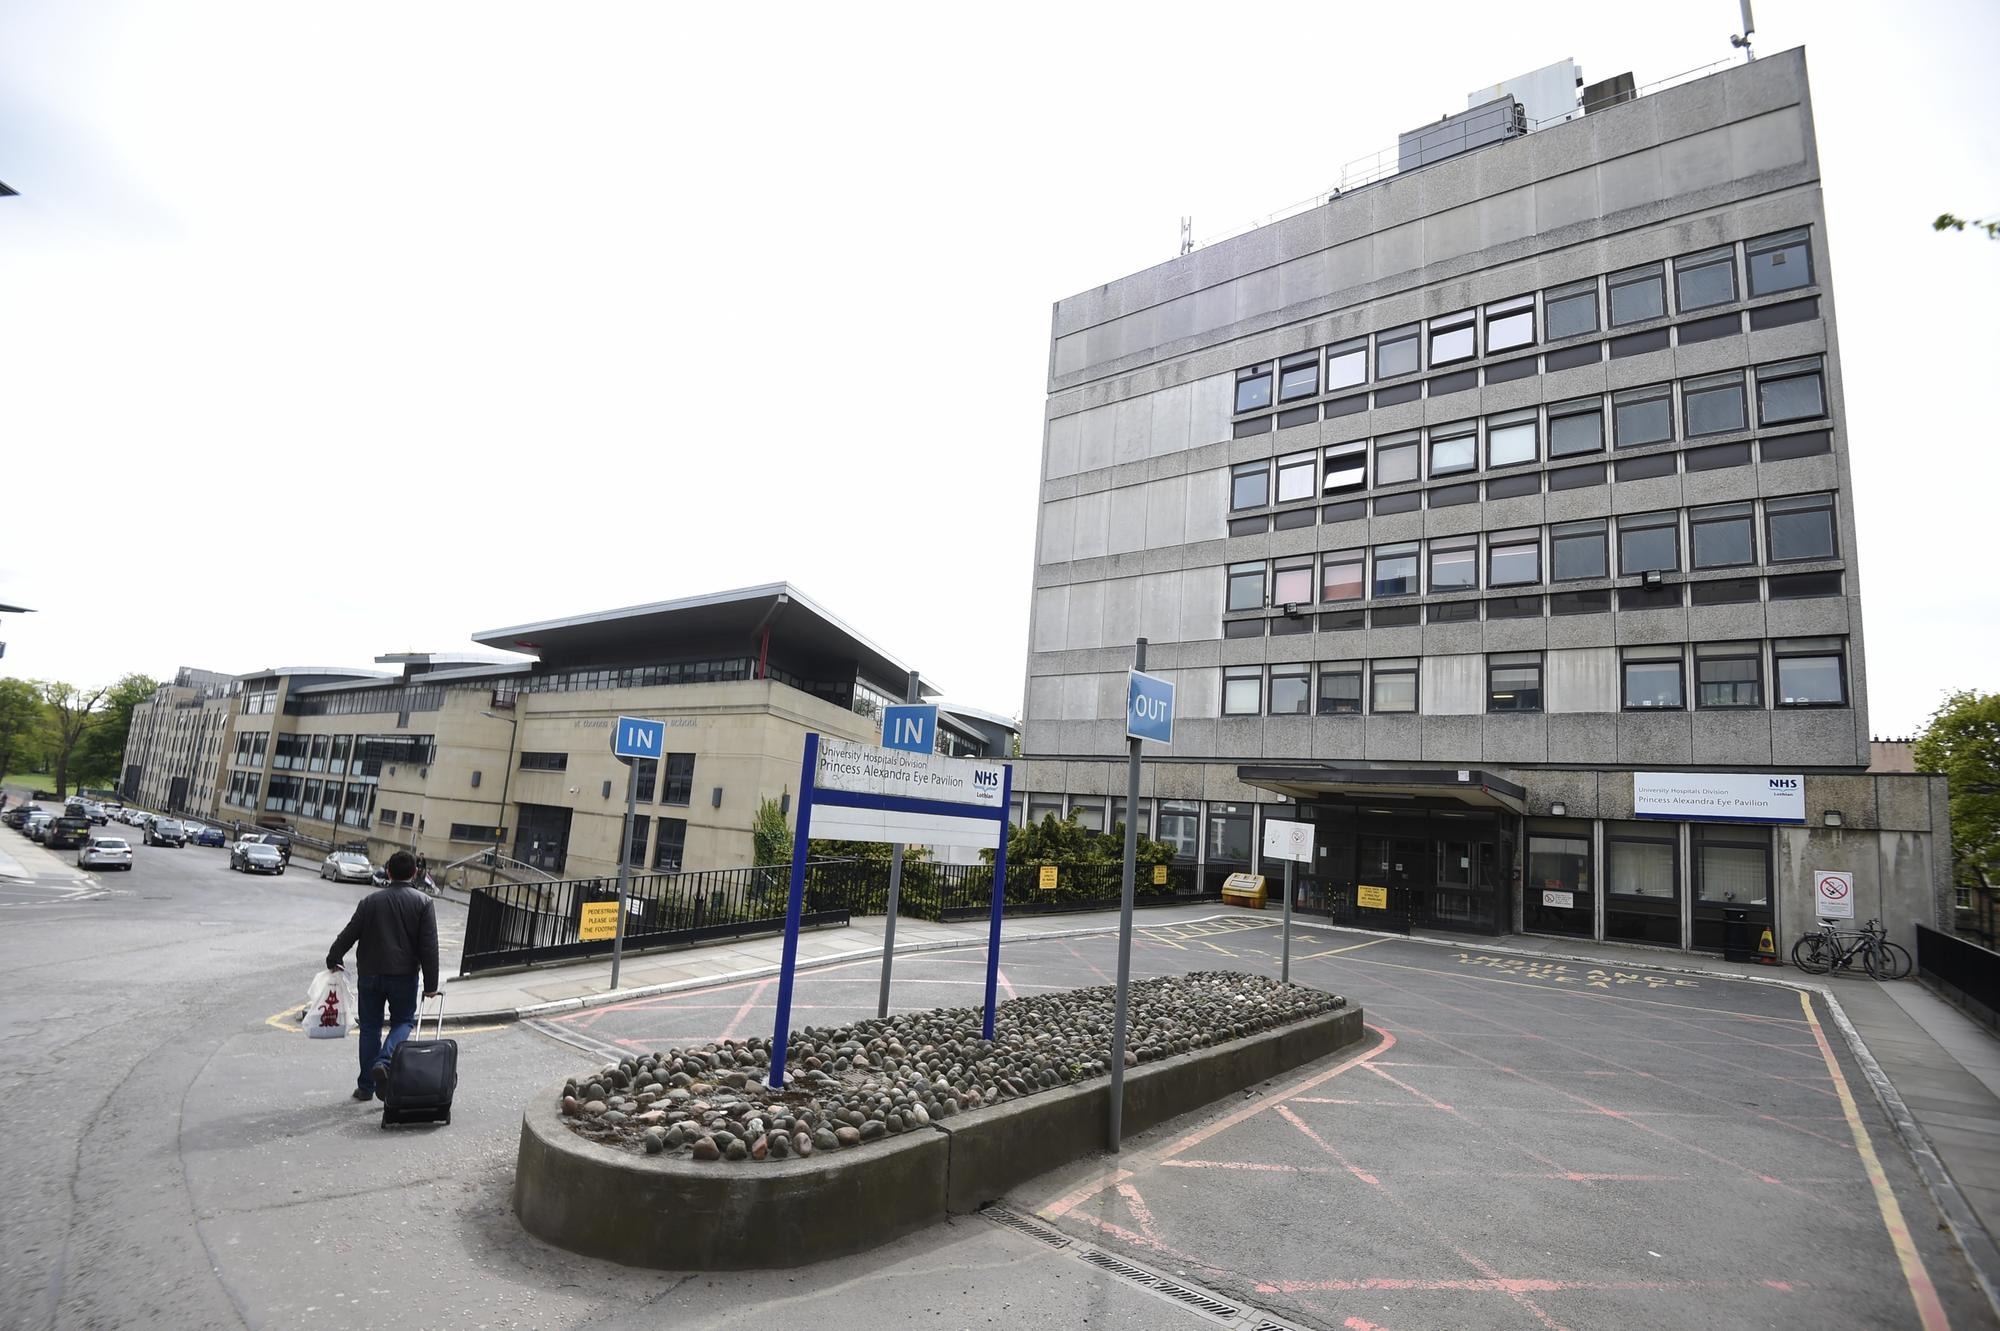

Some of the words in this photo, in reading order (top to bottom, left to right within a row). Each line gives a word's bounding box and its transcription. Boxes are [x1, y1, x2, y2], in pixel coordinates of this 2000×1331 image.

[1135, 694, 1167, 722] OUT
[628, 727, 653, 749] IN
[894, 717, 923, 744] IN
[821, 745, 861, 763] University
[863, 751, 898, 765] Hospitals
[900, 757, 927, 769] Division
[820, 758, 861, 775] Princess
[863, 764, 911, 781] Alexandra
[913, 771, 929, 785] Eye
[931, 773, 963, 787] Pavilion
[974, 769, 998, 786] NHS
[1638, 787, 1669, 795] University
[1769, 779, 1797, 788] NHS
[976, 791, 993, 799] Lothian
[1638, 796, 1671, 804] Princess
[1672, 797, 1714, 805] Alexandra
[1717, 798, 1732, 807] Eye
